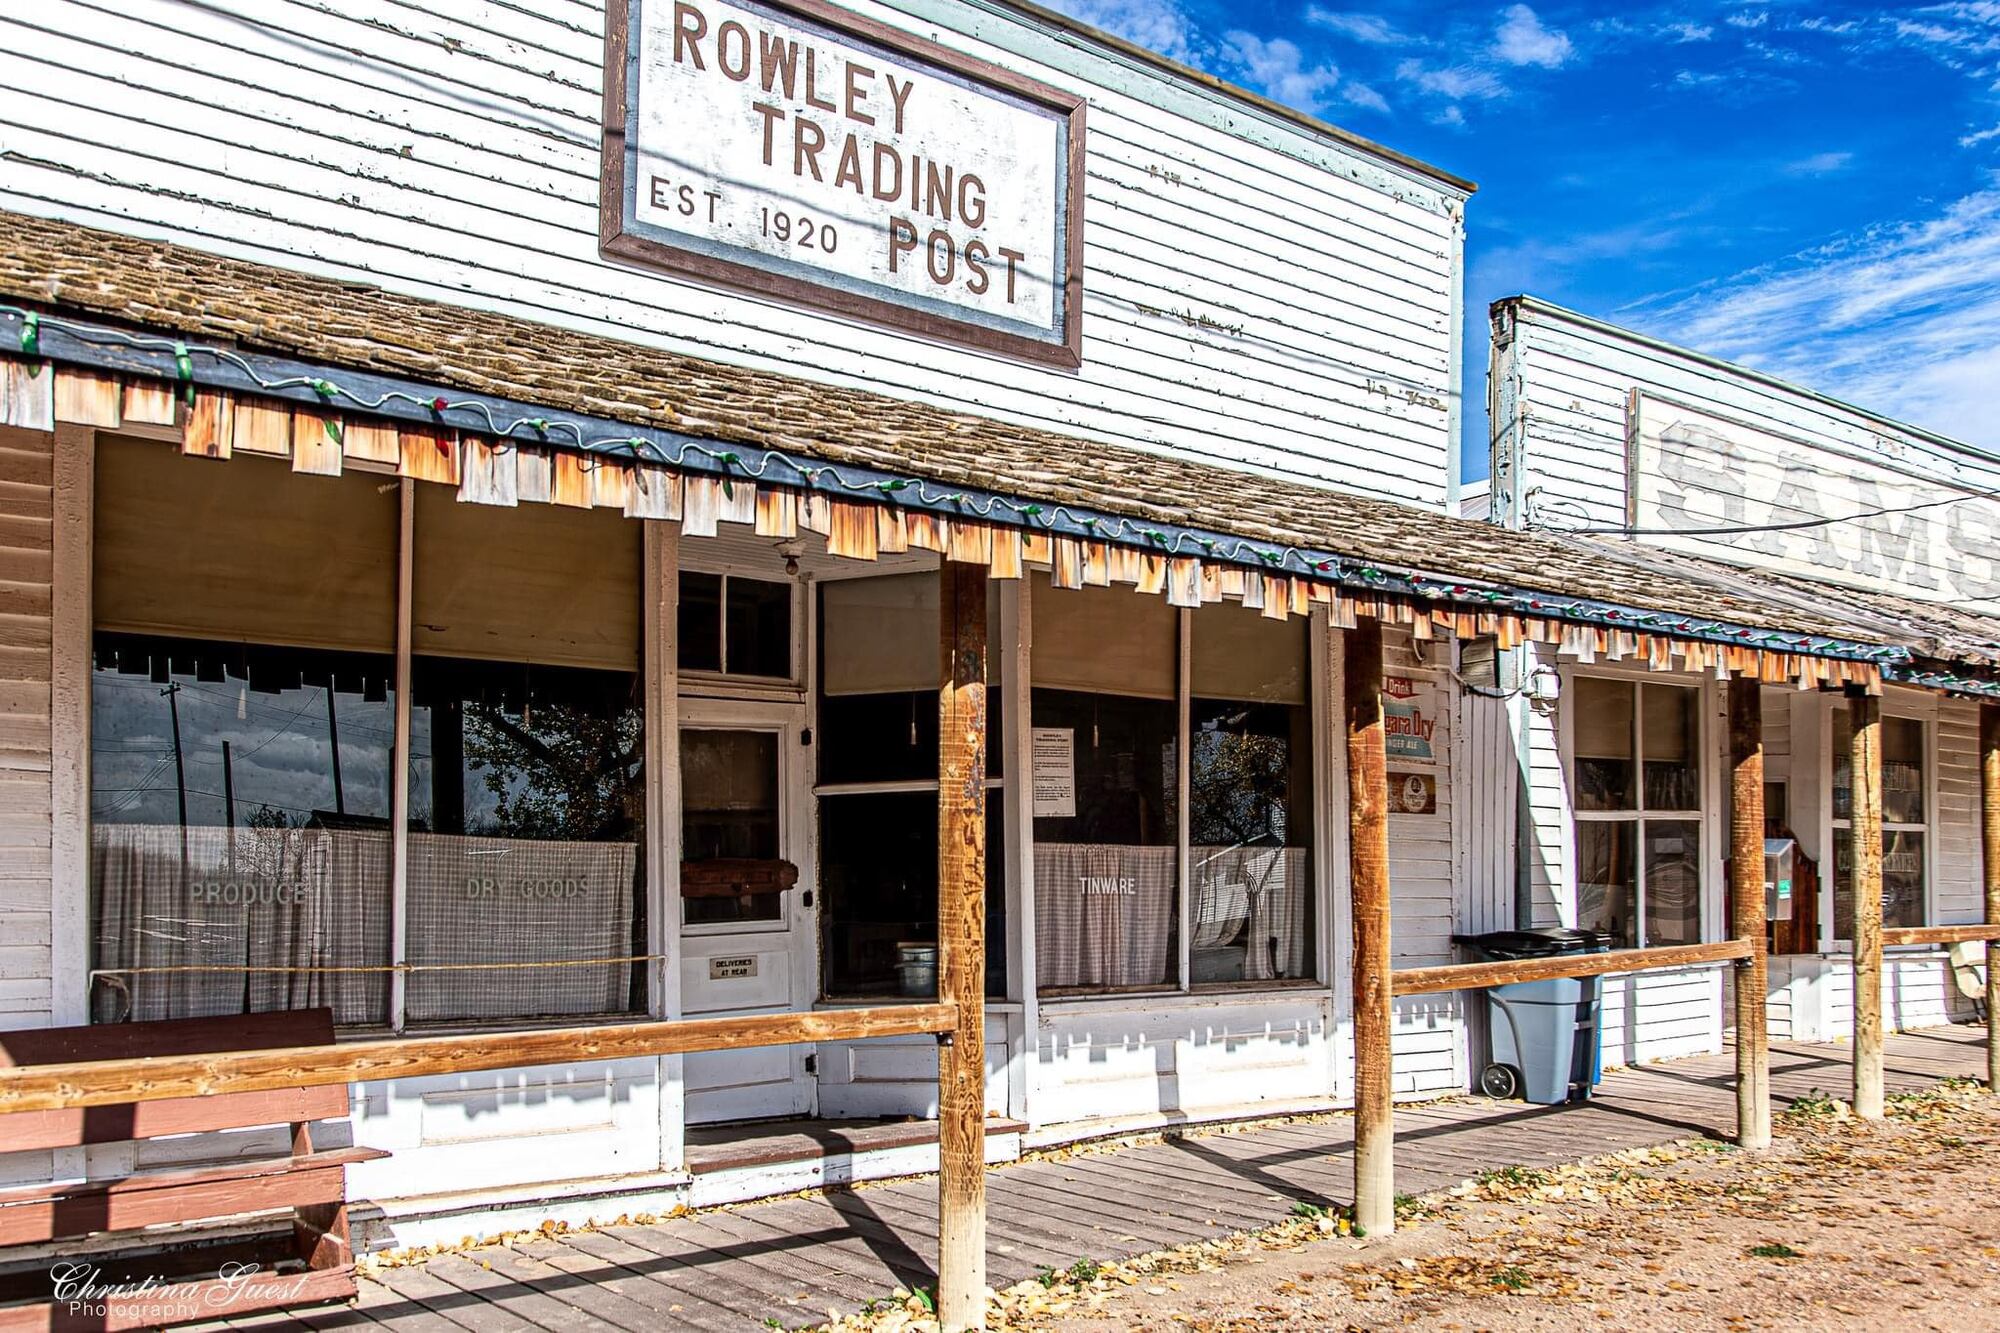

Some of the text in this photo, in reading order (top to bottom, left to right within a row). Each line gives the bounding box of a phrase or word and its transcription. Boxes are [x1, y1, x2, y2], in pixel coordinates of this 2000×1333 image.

[673, 1, 914, 134] ROWLEY
[753, 101, 987, 230] TRADING
[650, 175, 838, 254] EST. 1920
[889, 215, 1026, 304] POST
[1657, 420, 2000, 601] SAMS
[1388, 678, 1411, 695] Drink
[1385, 711, 1435, 741] gara Dry
[189, 882, 306, 904] PRODUCE
[467, 878, 589, 898] DRY GOODS
[1079, 877, 1136, 895] TINWARE
[715, 959, 752, 968] DELIVERIES
